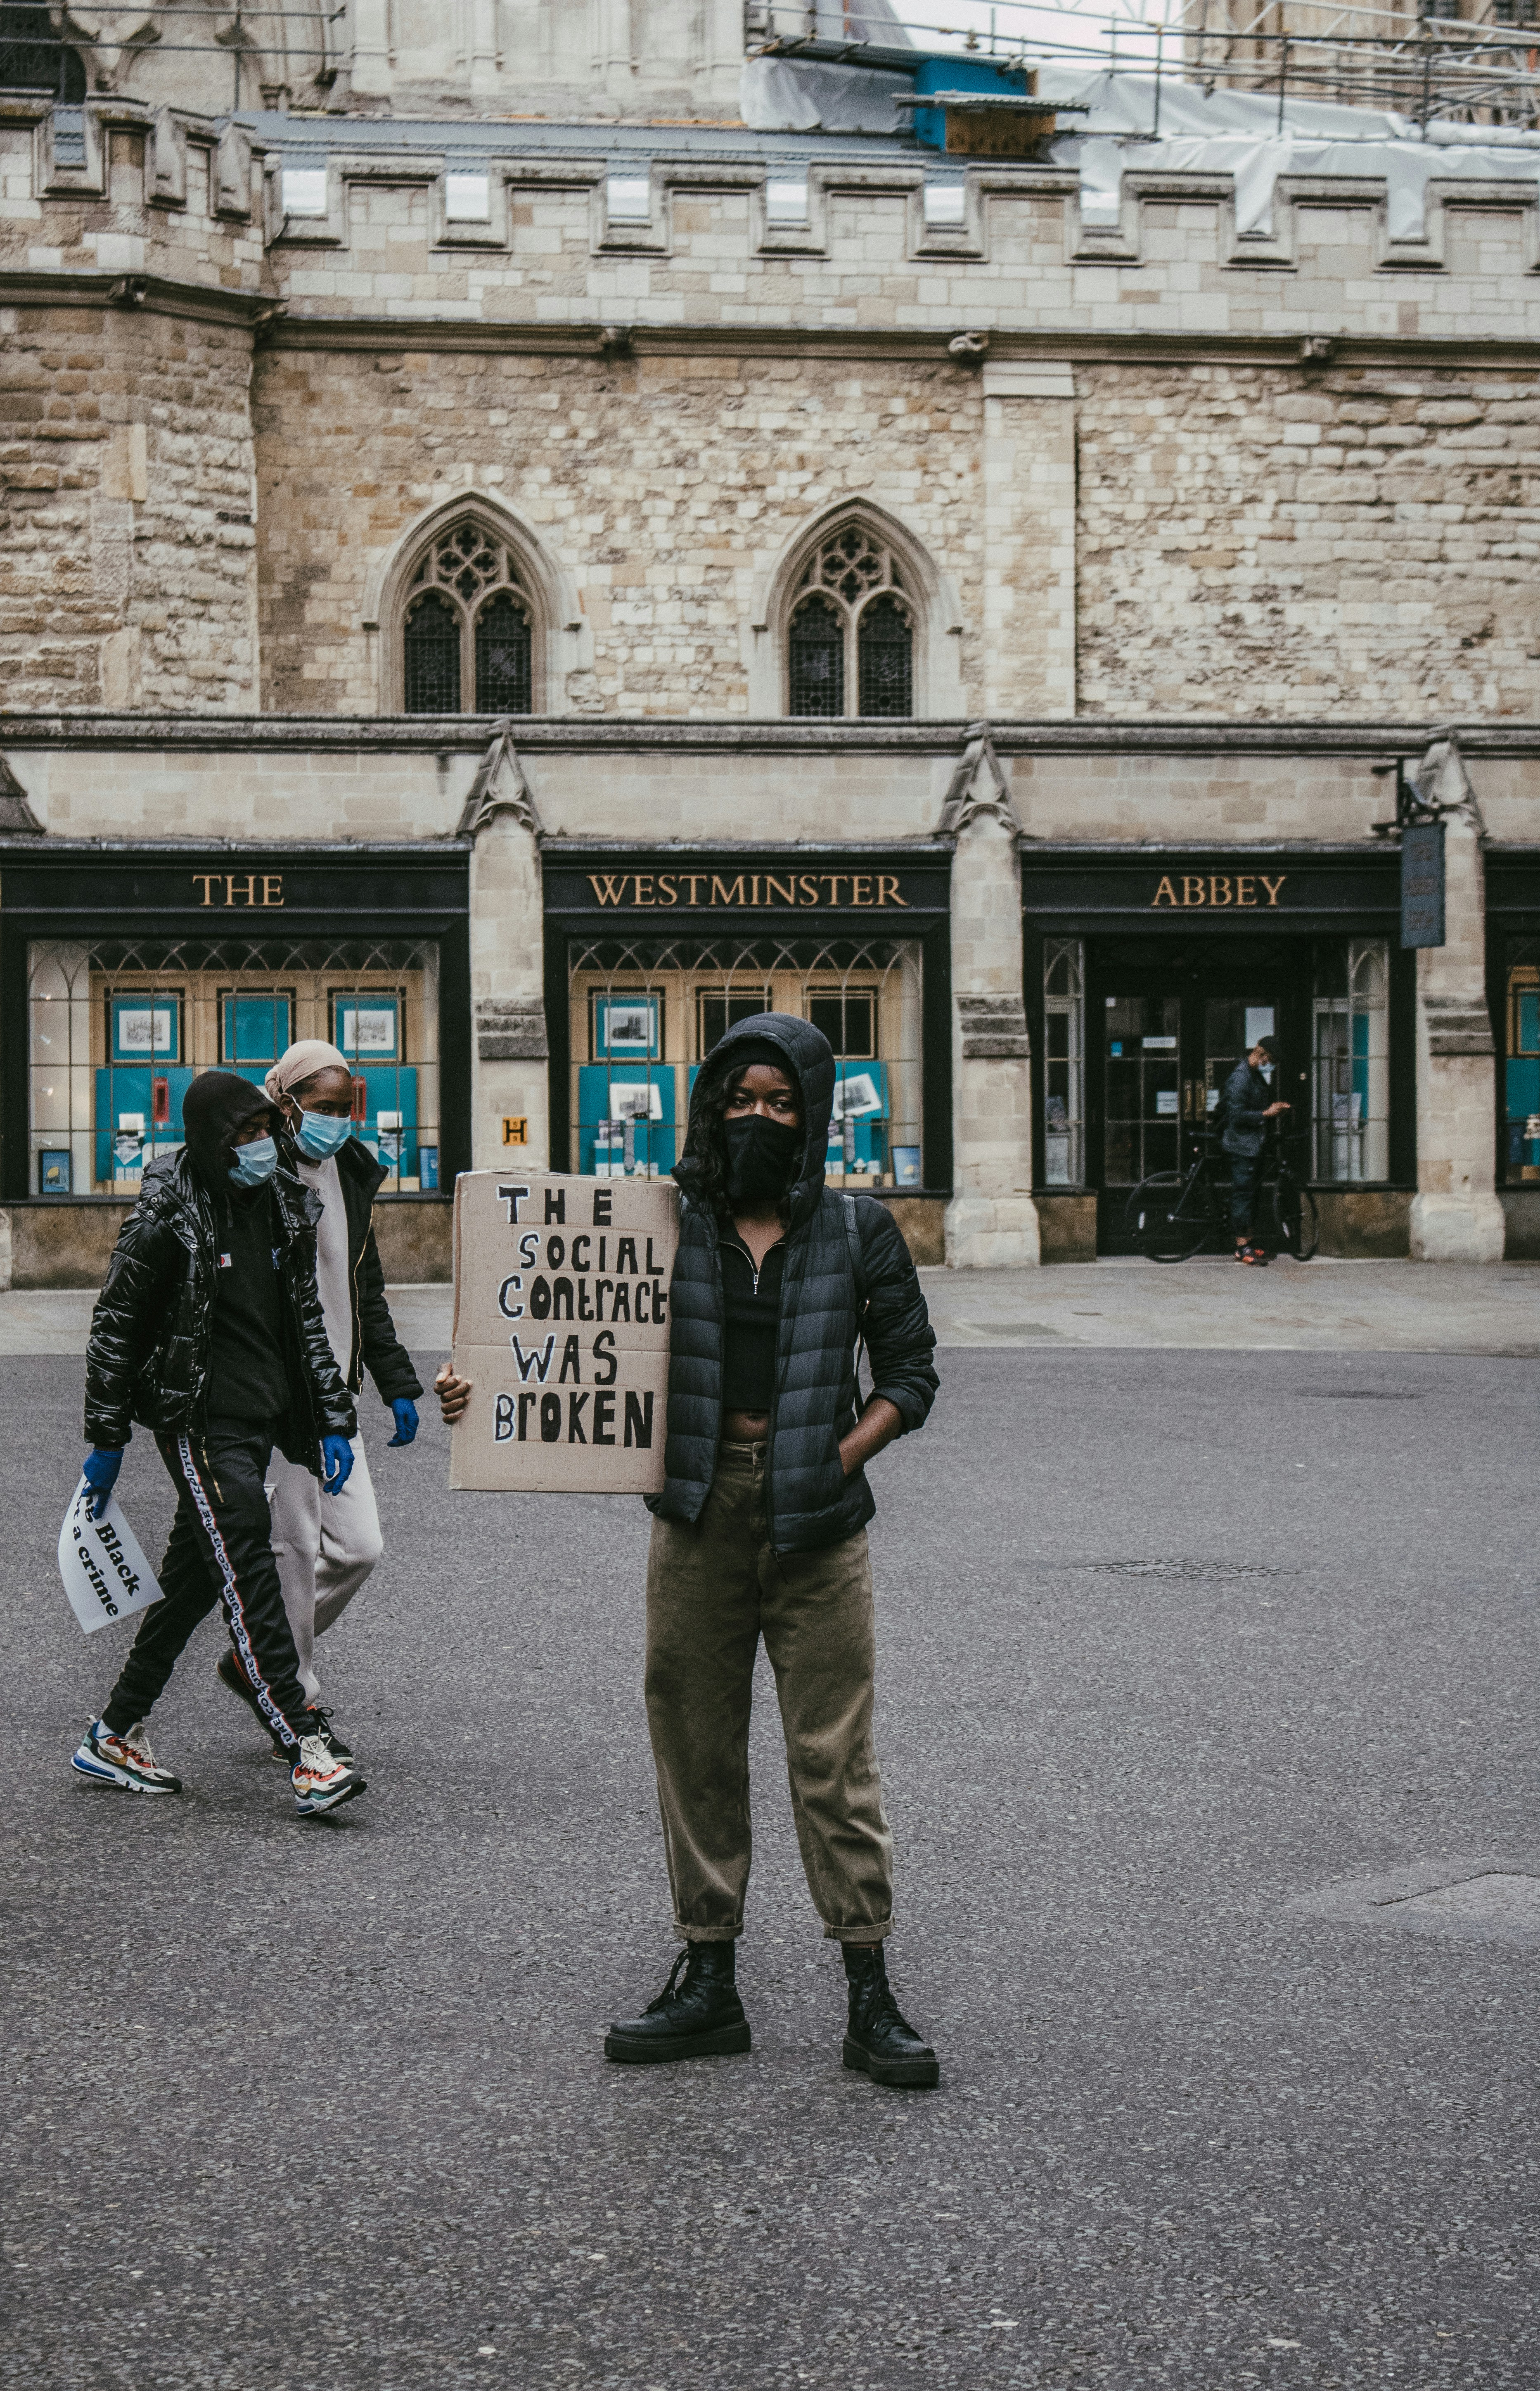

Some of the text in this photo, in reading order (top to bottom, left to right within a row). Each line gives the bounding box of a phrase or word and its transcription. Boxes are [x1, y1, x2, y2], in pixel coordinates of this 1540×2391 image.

[192, 874, 1287, 907] THE WESTMINSTER ABBEY
[502, 1120, 527, 1145] H
[497, 1184, 612, 1226] THE
[518, 1231, 664, 1275] SOCIAL
[510, 1330, 617, 1385] WAS
[73, 1526, 81, 1541] a
[78, 1546, 118, 1617] crime
[95, 1522, 140, 1597] Black
[248, 1659, 274, 1714] COURE
